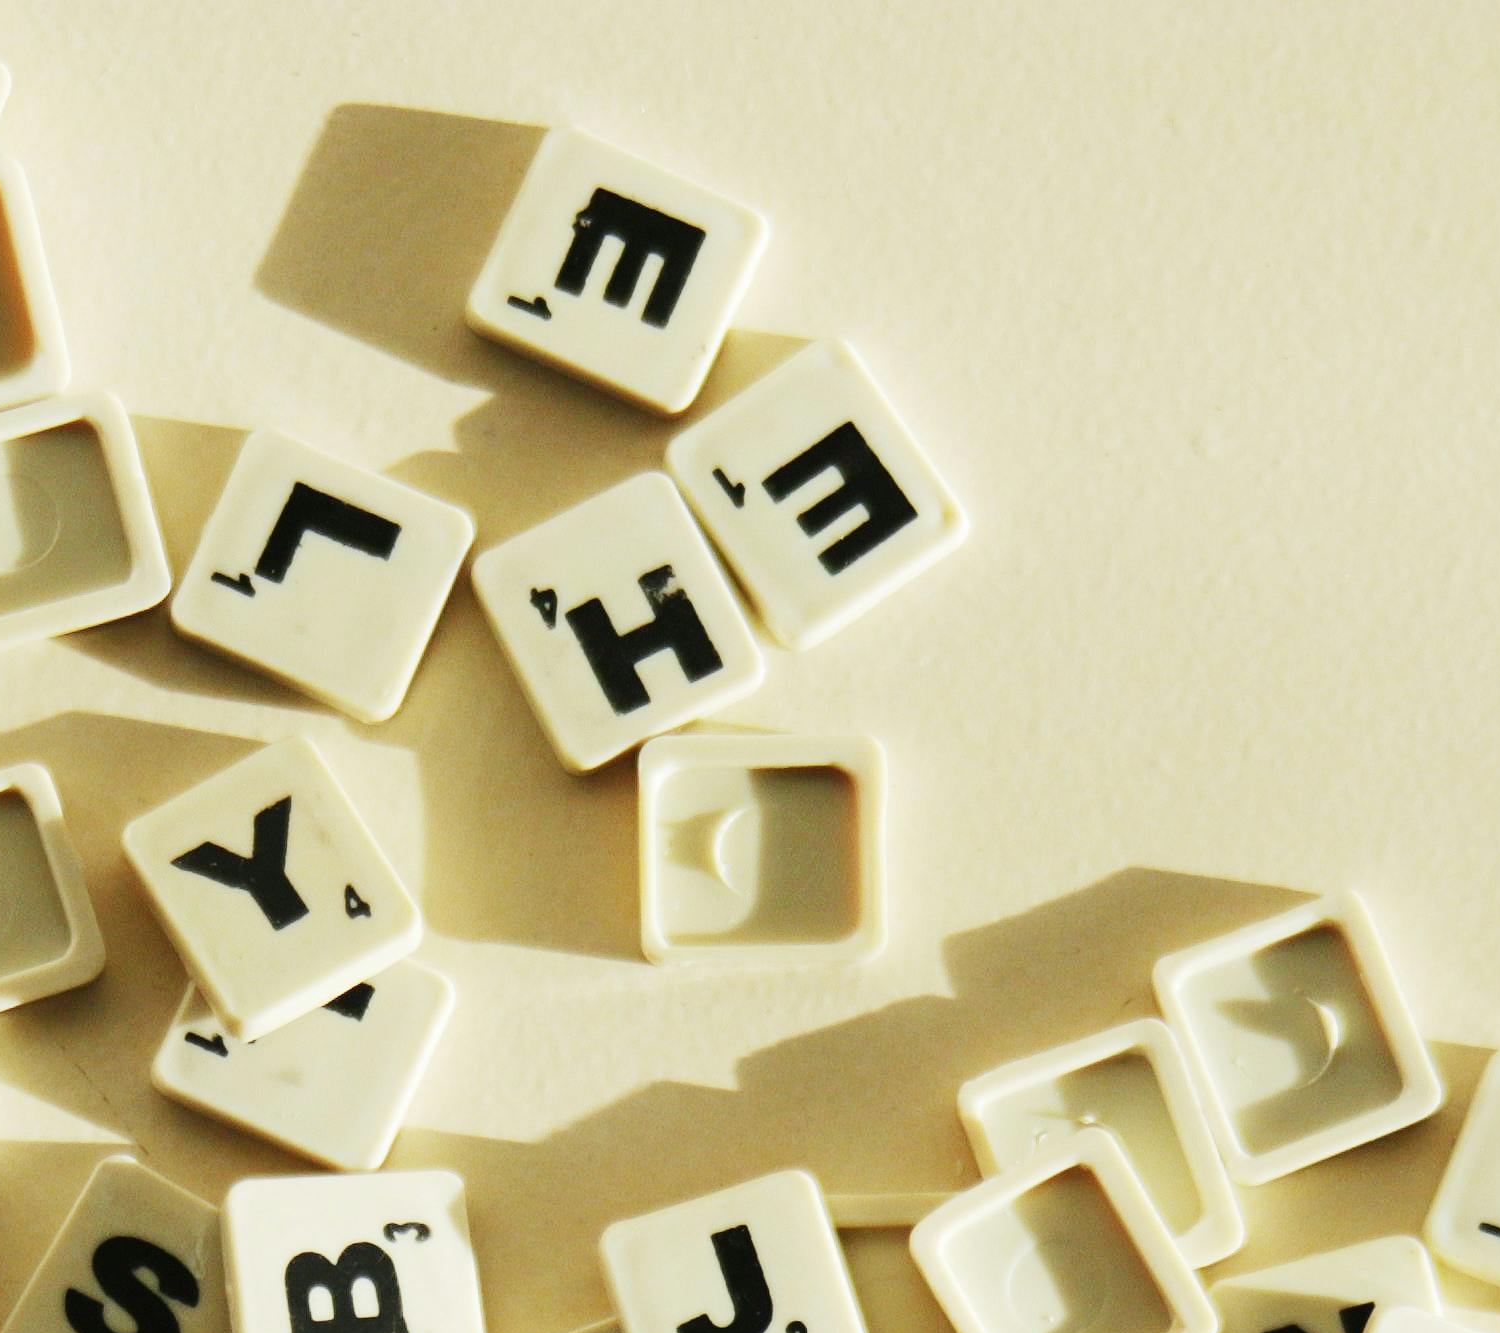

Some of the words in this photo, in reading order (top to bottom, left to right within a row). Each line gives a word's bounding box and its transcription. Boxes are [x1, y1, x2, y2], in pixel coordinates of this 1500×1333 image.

[555, 188, 706, 327] E
[508, 296, 551, 319] 1
[713, 468, 745, 508] 1
[762, 422, 918, 575] E
[255, 482, 401, 583] L
[211, 572, 255, 597] 1
[530, 588, 557, 628] 4
[565, 565, 723, 714] H
[171, 796, 309, 930] Y
[344, 885, 371, 918] 4
[185, 1032, 228, 1057] 1
[383, 1222, 431, 1244] 3
